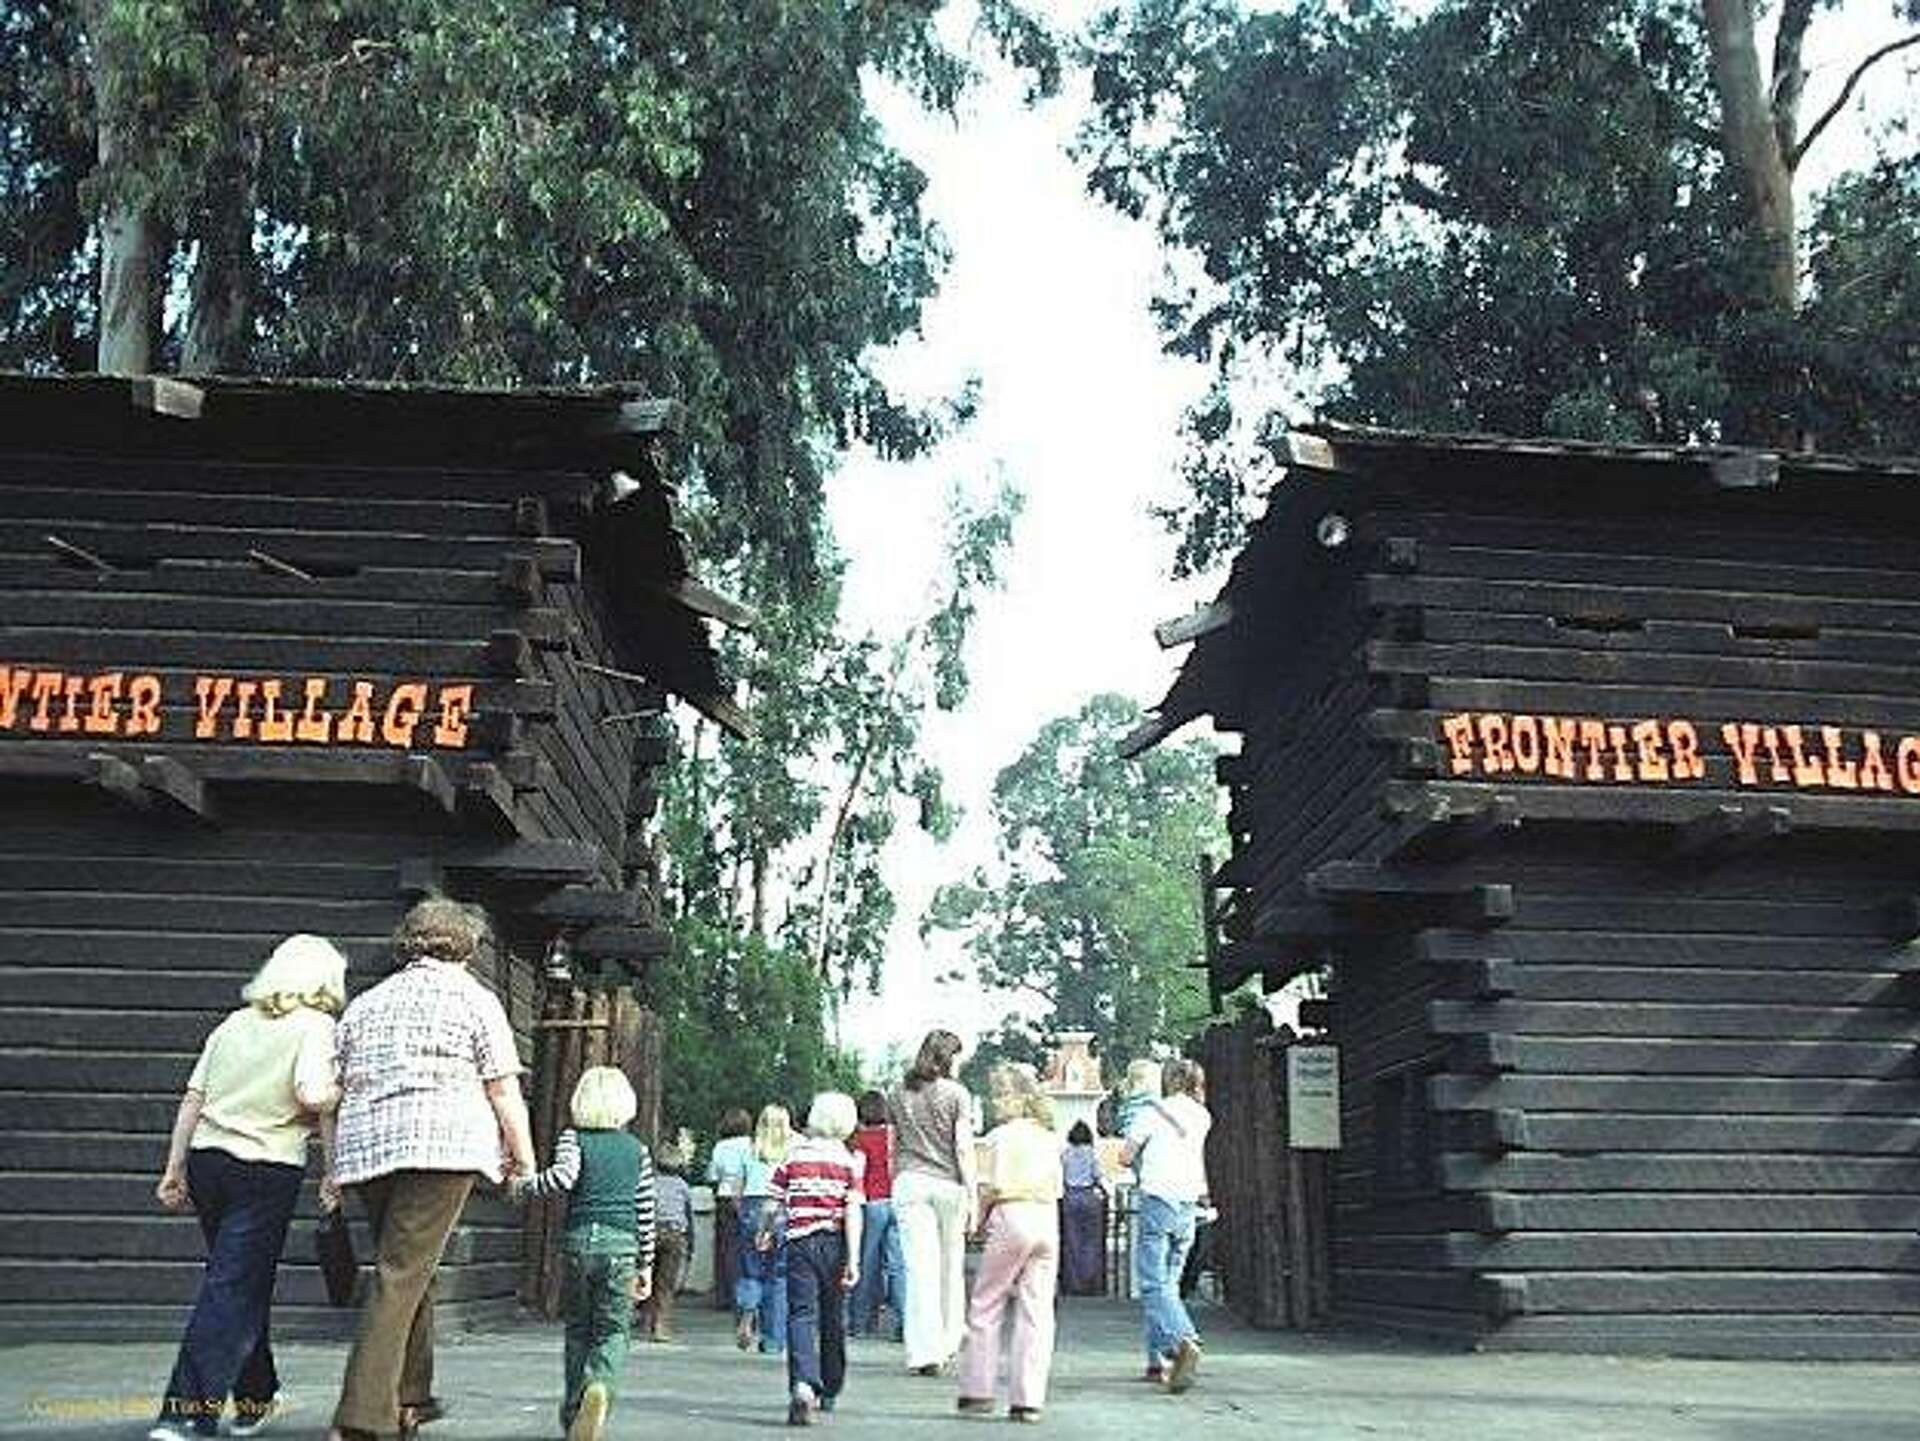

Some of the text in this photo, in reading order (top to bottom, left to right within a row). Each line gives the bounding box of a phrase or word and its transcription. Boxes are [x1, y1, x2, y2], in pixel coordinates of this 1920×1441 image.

[195, 676, 473, 748] VILLAGE
[1442, 712, 1920, 794] FRONTIER VILLAG
